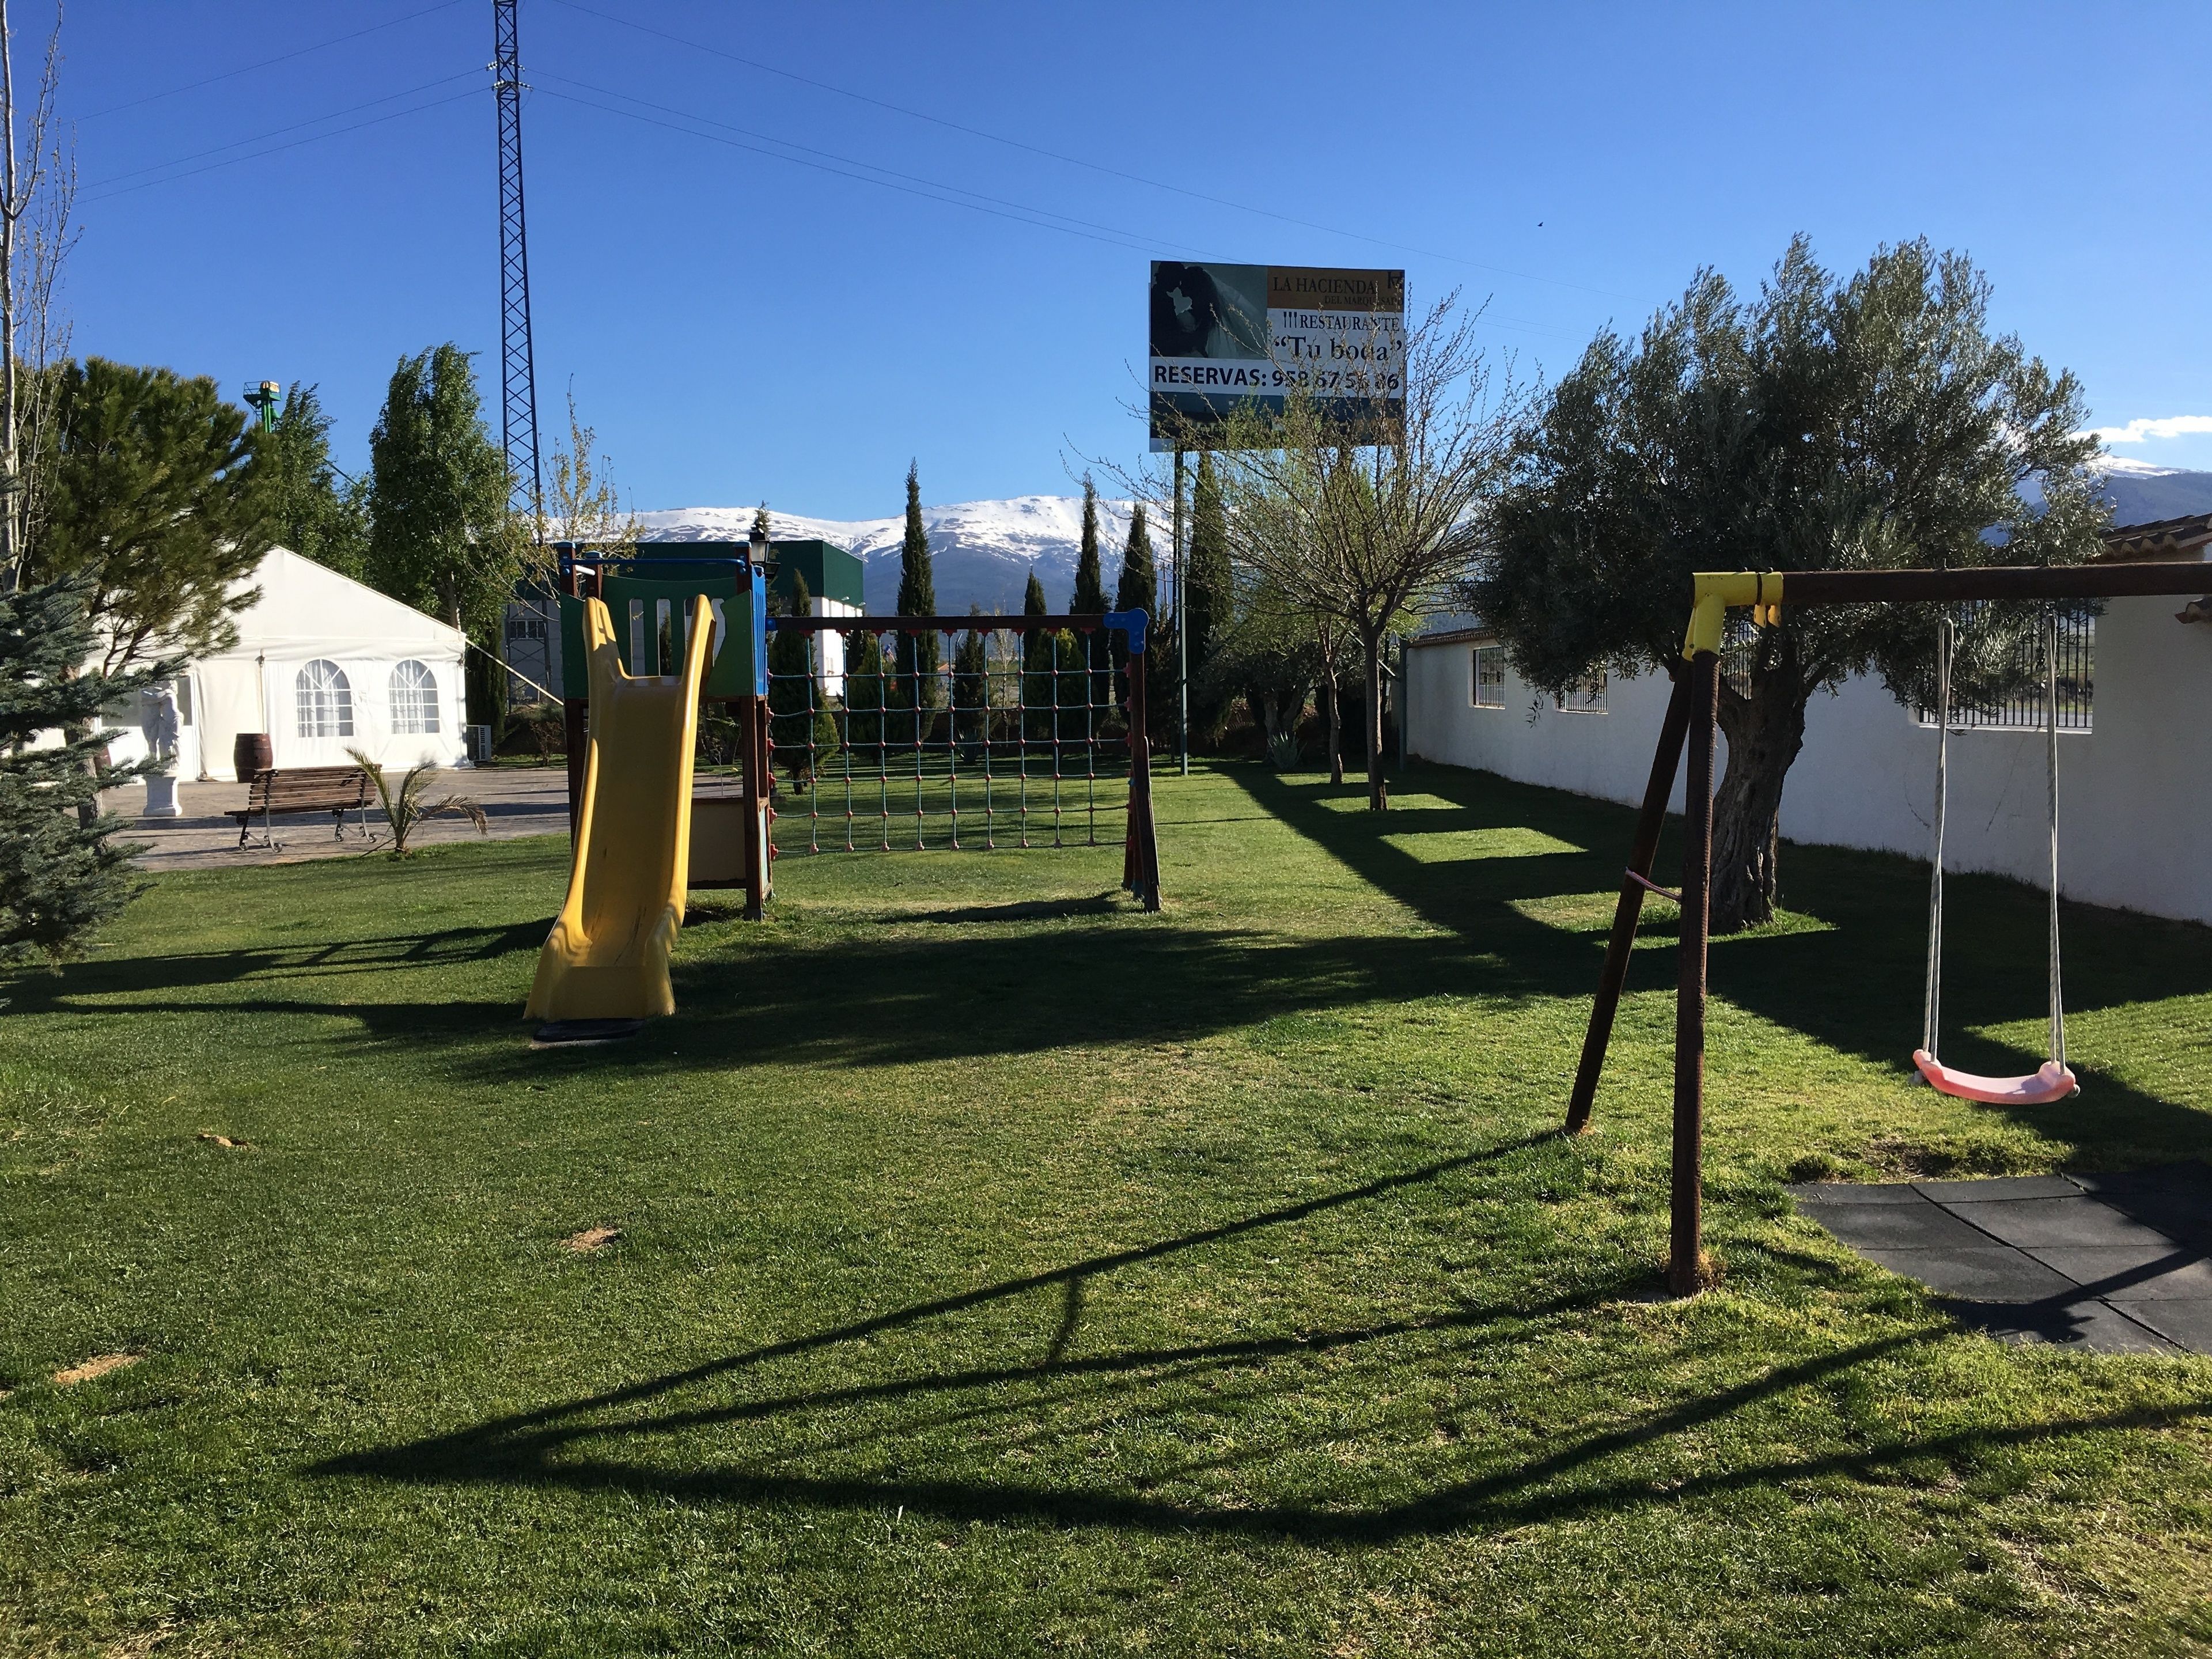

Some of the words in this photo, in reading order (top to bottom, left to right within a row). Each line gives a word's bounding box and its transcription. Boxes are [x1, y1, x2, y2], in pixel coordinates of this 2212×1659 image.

[1274, 277, 1291, 291] LA
[1296, 278, 1376, 294] HACIENDA
[1324, 295, 1342, 305] DEL
[1300, 315, 1400, 331] RESTAURANTE
[1154, 365, 1267, 387] RESERVAS:
[1272, 370, 1309, 388] 958
